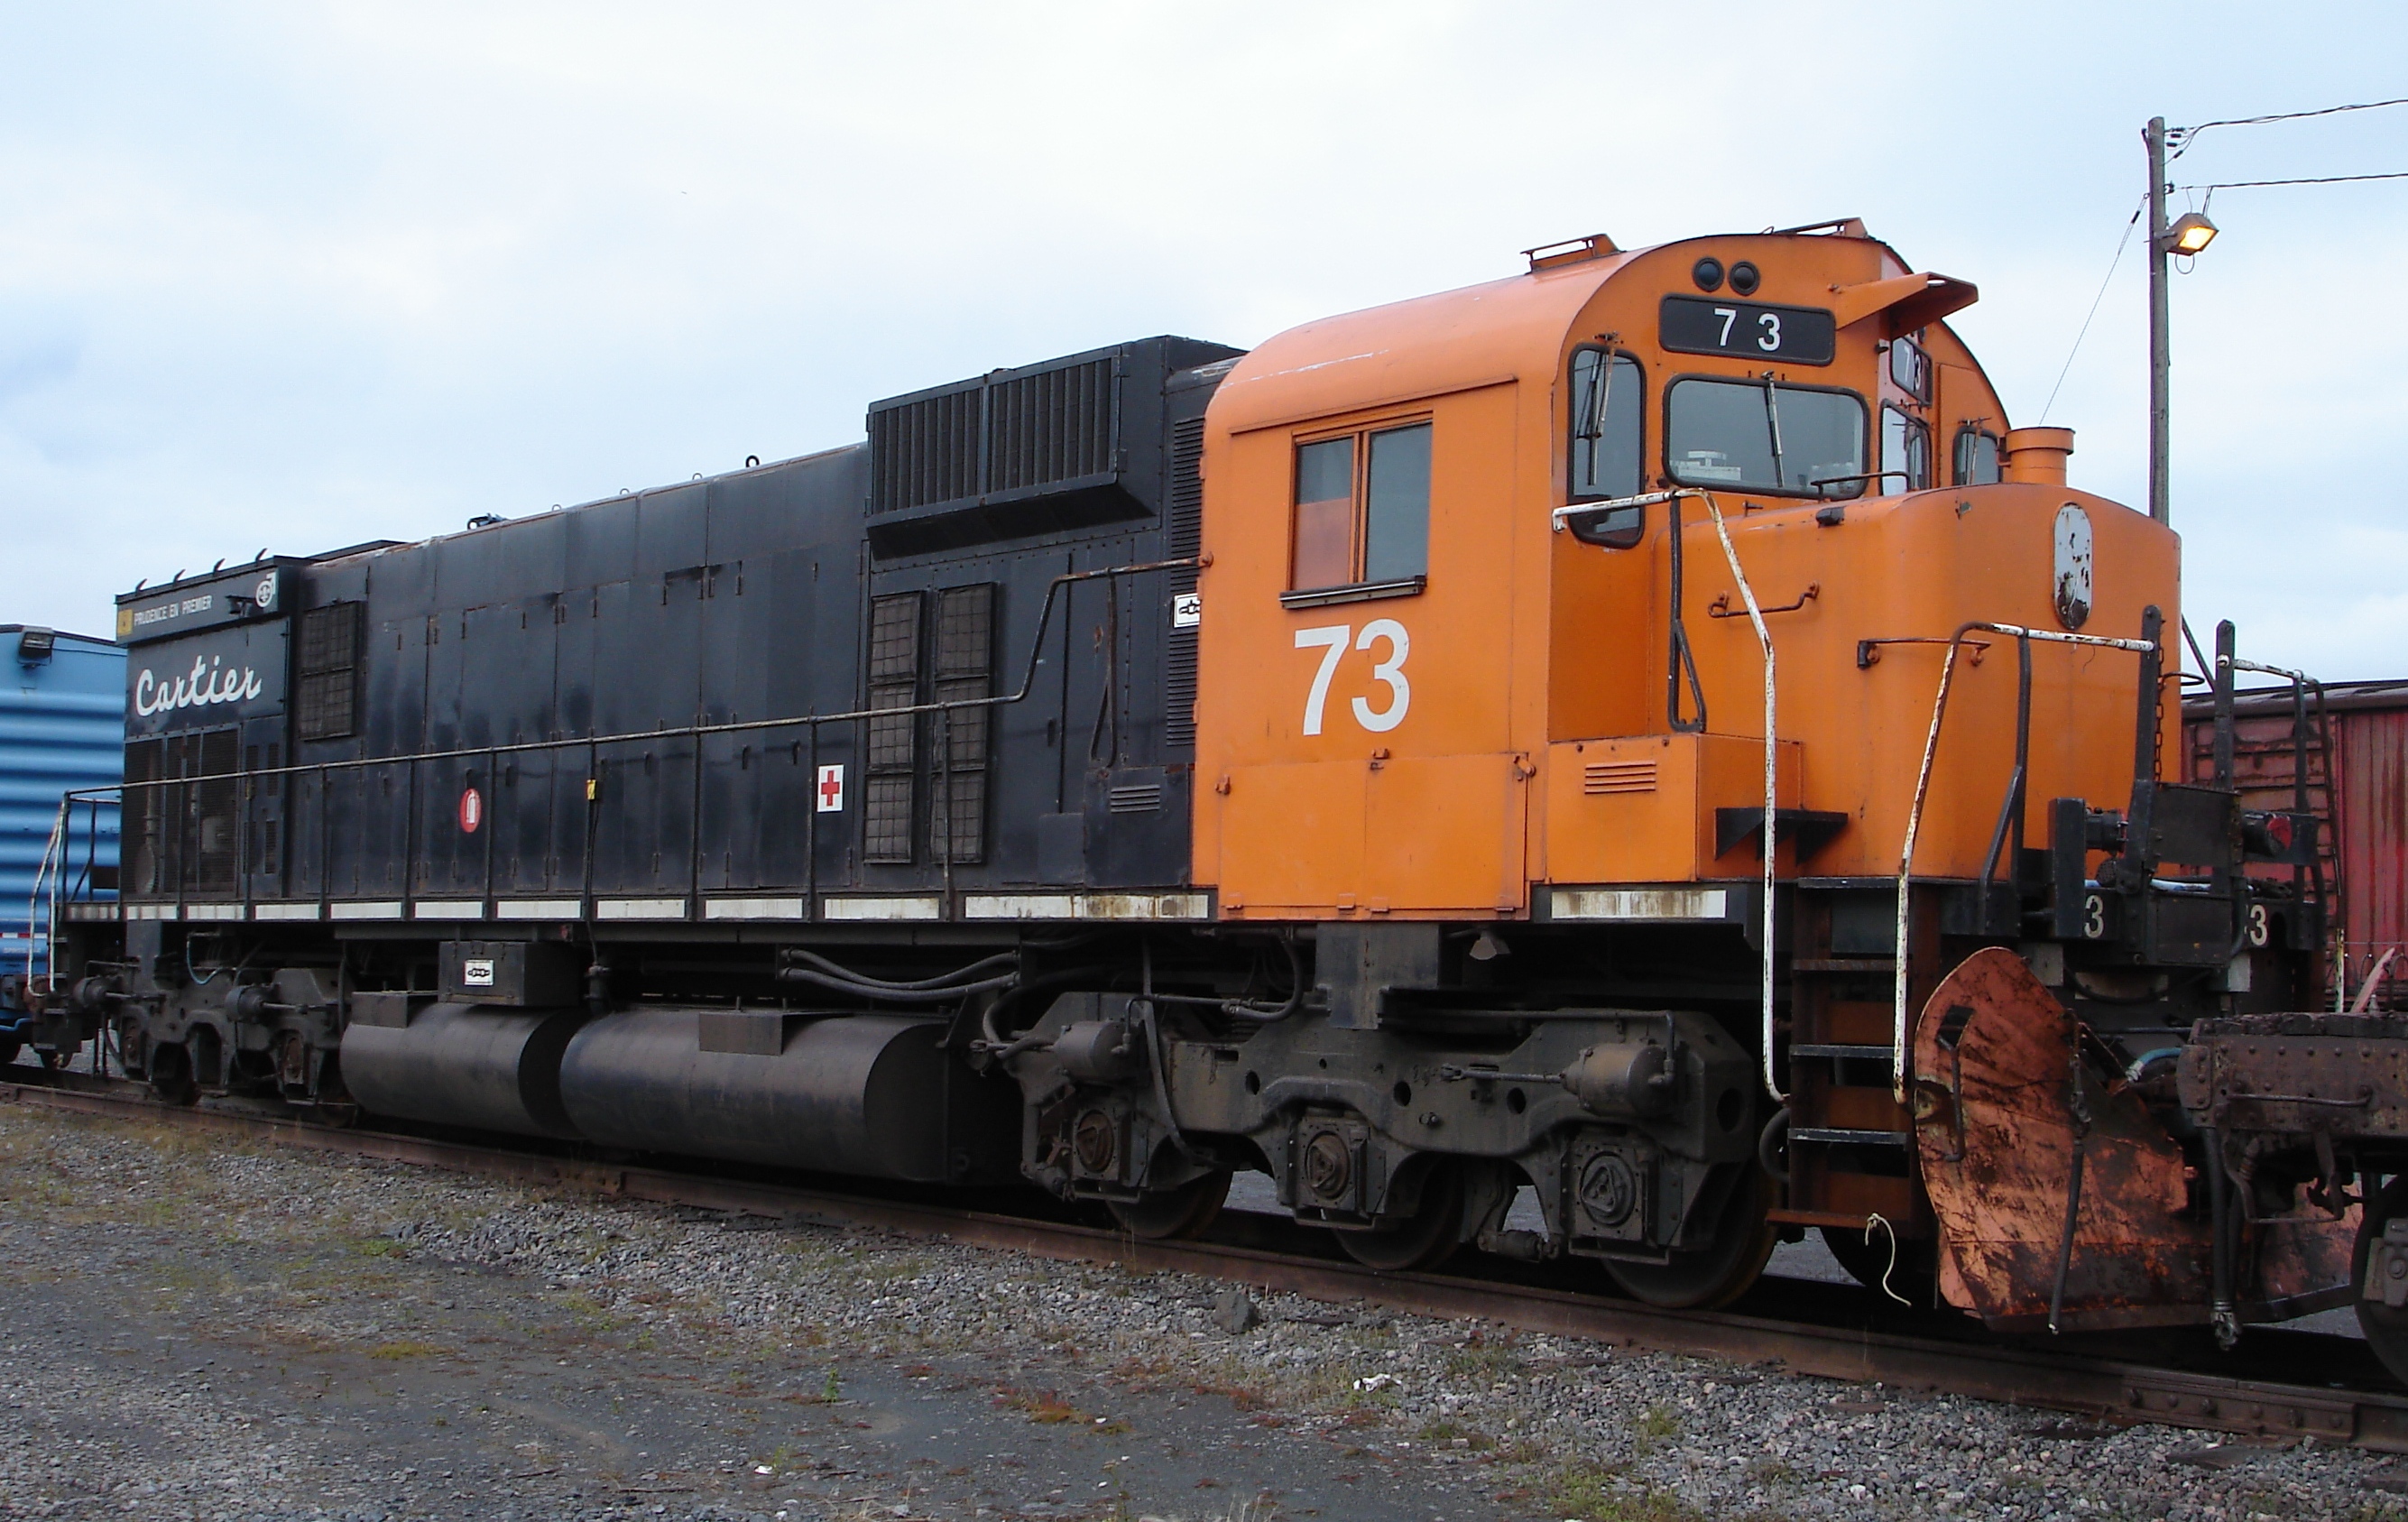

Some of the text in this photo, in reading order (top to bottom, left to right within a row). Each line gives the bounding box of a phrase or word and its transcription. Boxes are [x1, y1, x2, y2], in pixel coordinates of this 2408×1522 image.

[1714, 308, 1781, 351] 7 3
[134, 595, 212, 626] PRUDENCE EN PREMIER
[136, 655, 262, 716] Cartier
[1295, 619, 1410, 735] 73
[2244, 904, 2268, 946] 3
